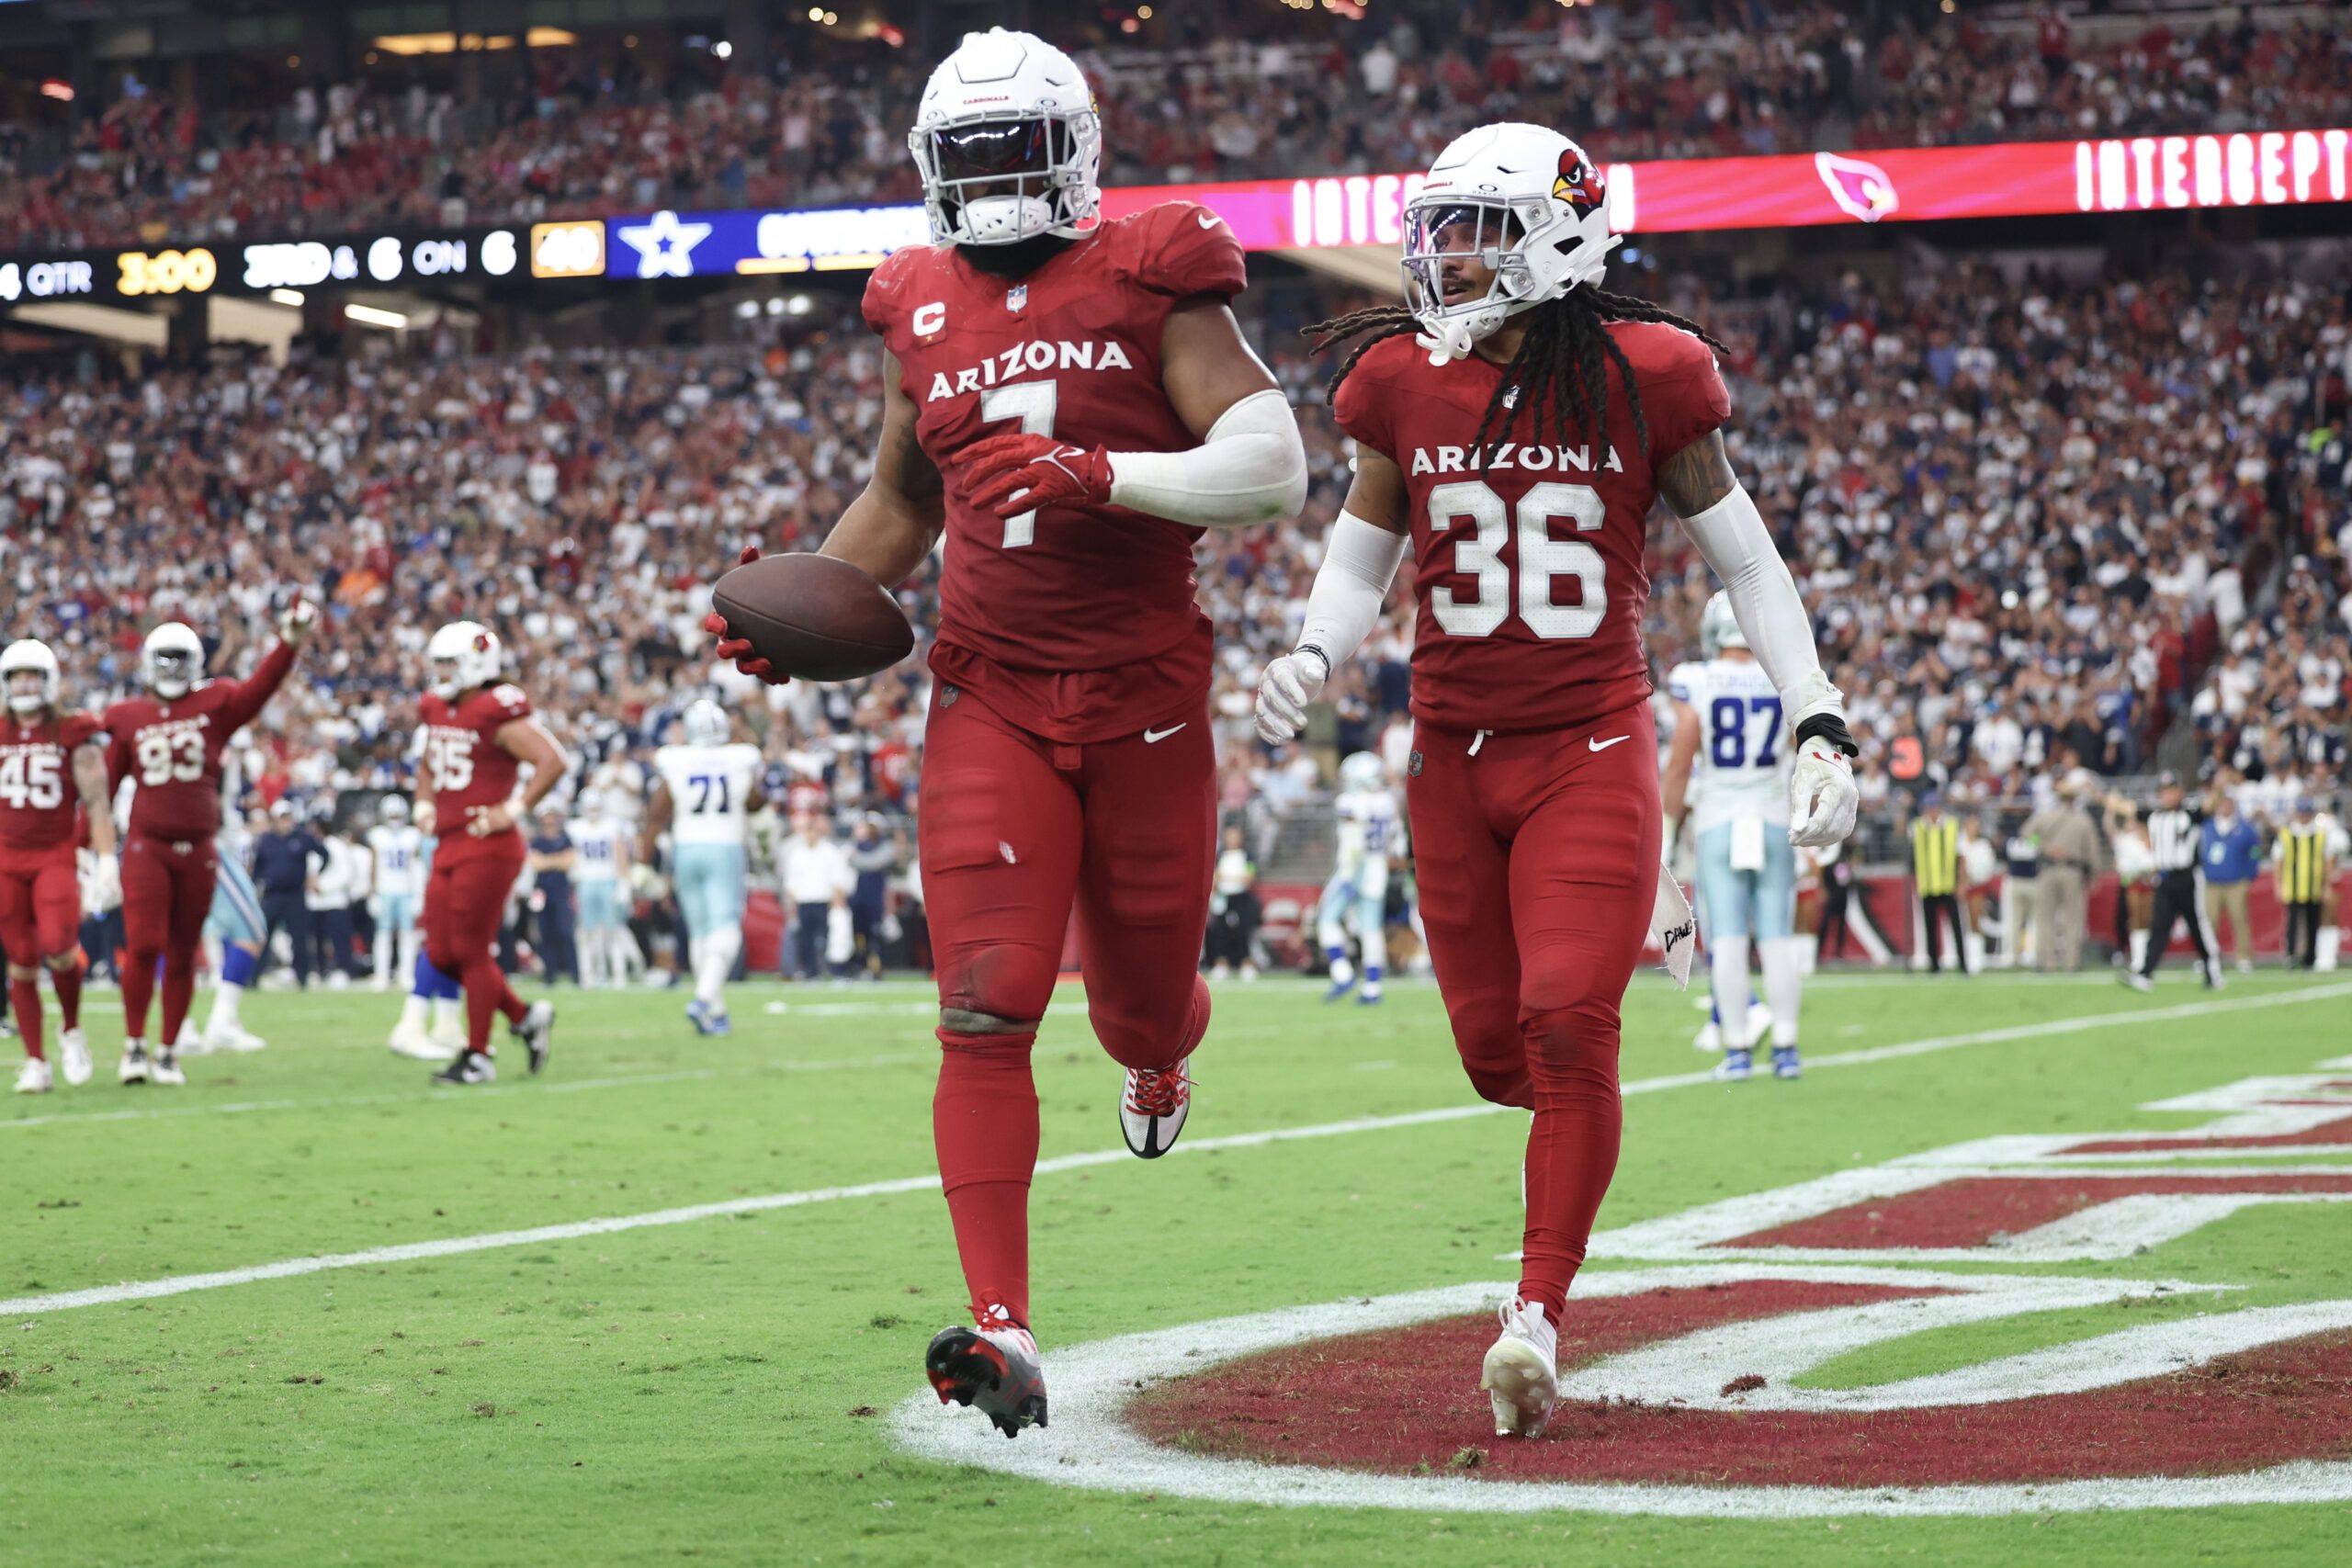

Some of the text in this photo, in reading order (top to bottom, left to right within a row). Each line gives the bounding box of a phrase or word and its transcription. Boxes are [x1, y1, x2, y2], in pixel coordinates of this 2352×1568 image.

[368, 236, 403, 281] 6
[413, 240, 467, 276] ON
[481, 230, 516, 276] 6
[912, 301, 945, 337] C
[927, 340, 1133, 402] ARIZONA
[979, 378, 1057, 548] 7
[1411, 443, 1624, 477] ARIZONA
[1427, 479, 1608, 639] 36
[138, 730, 206, 787] 93
[1711, 696, 1783, 768] 87
[0, 753, 63, 809] 45
[688, 775, 729, 814] 71
